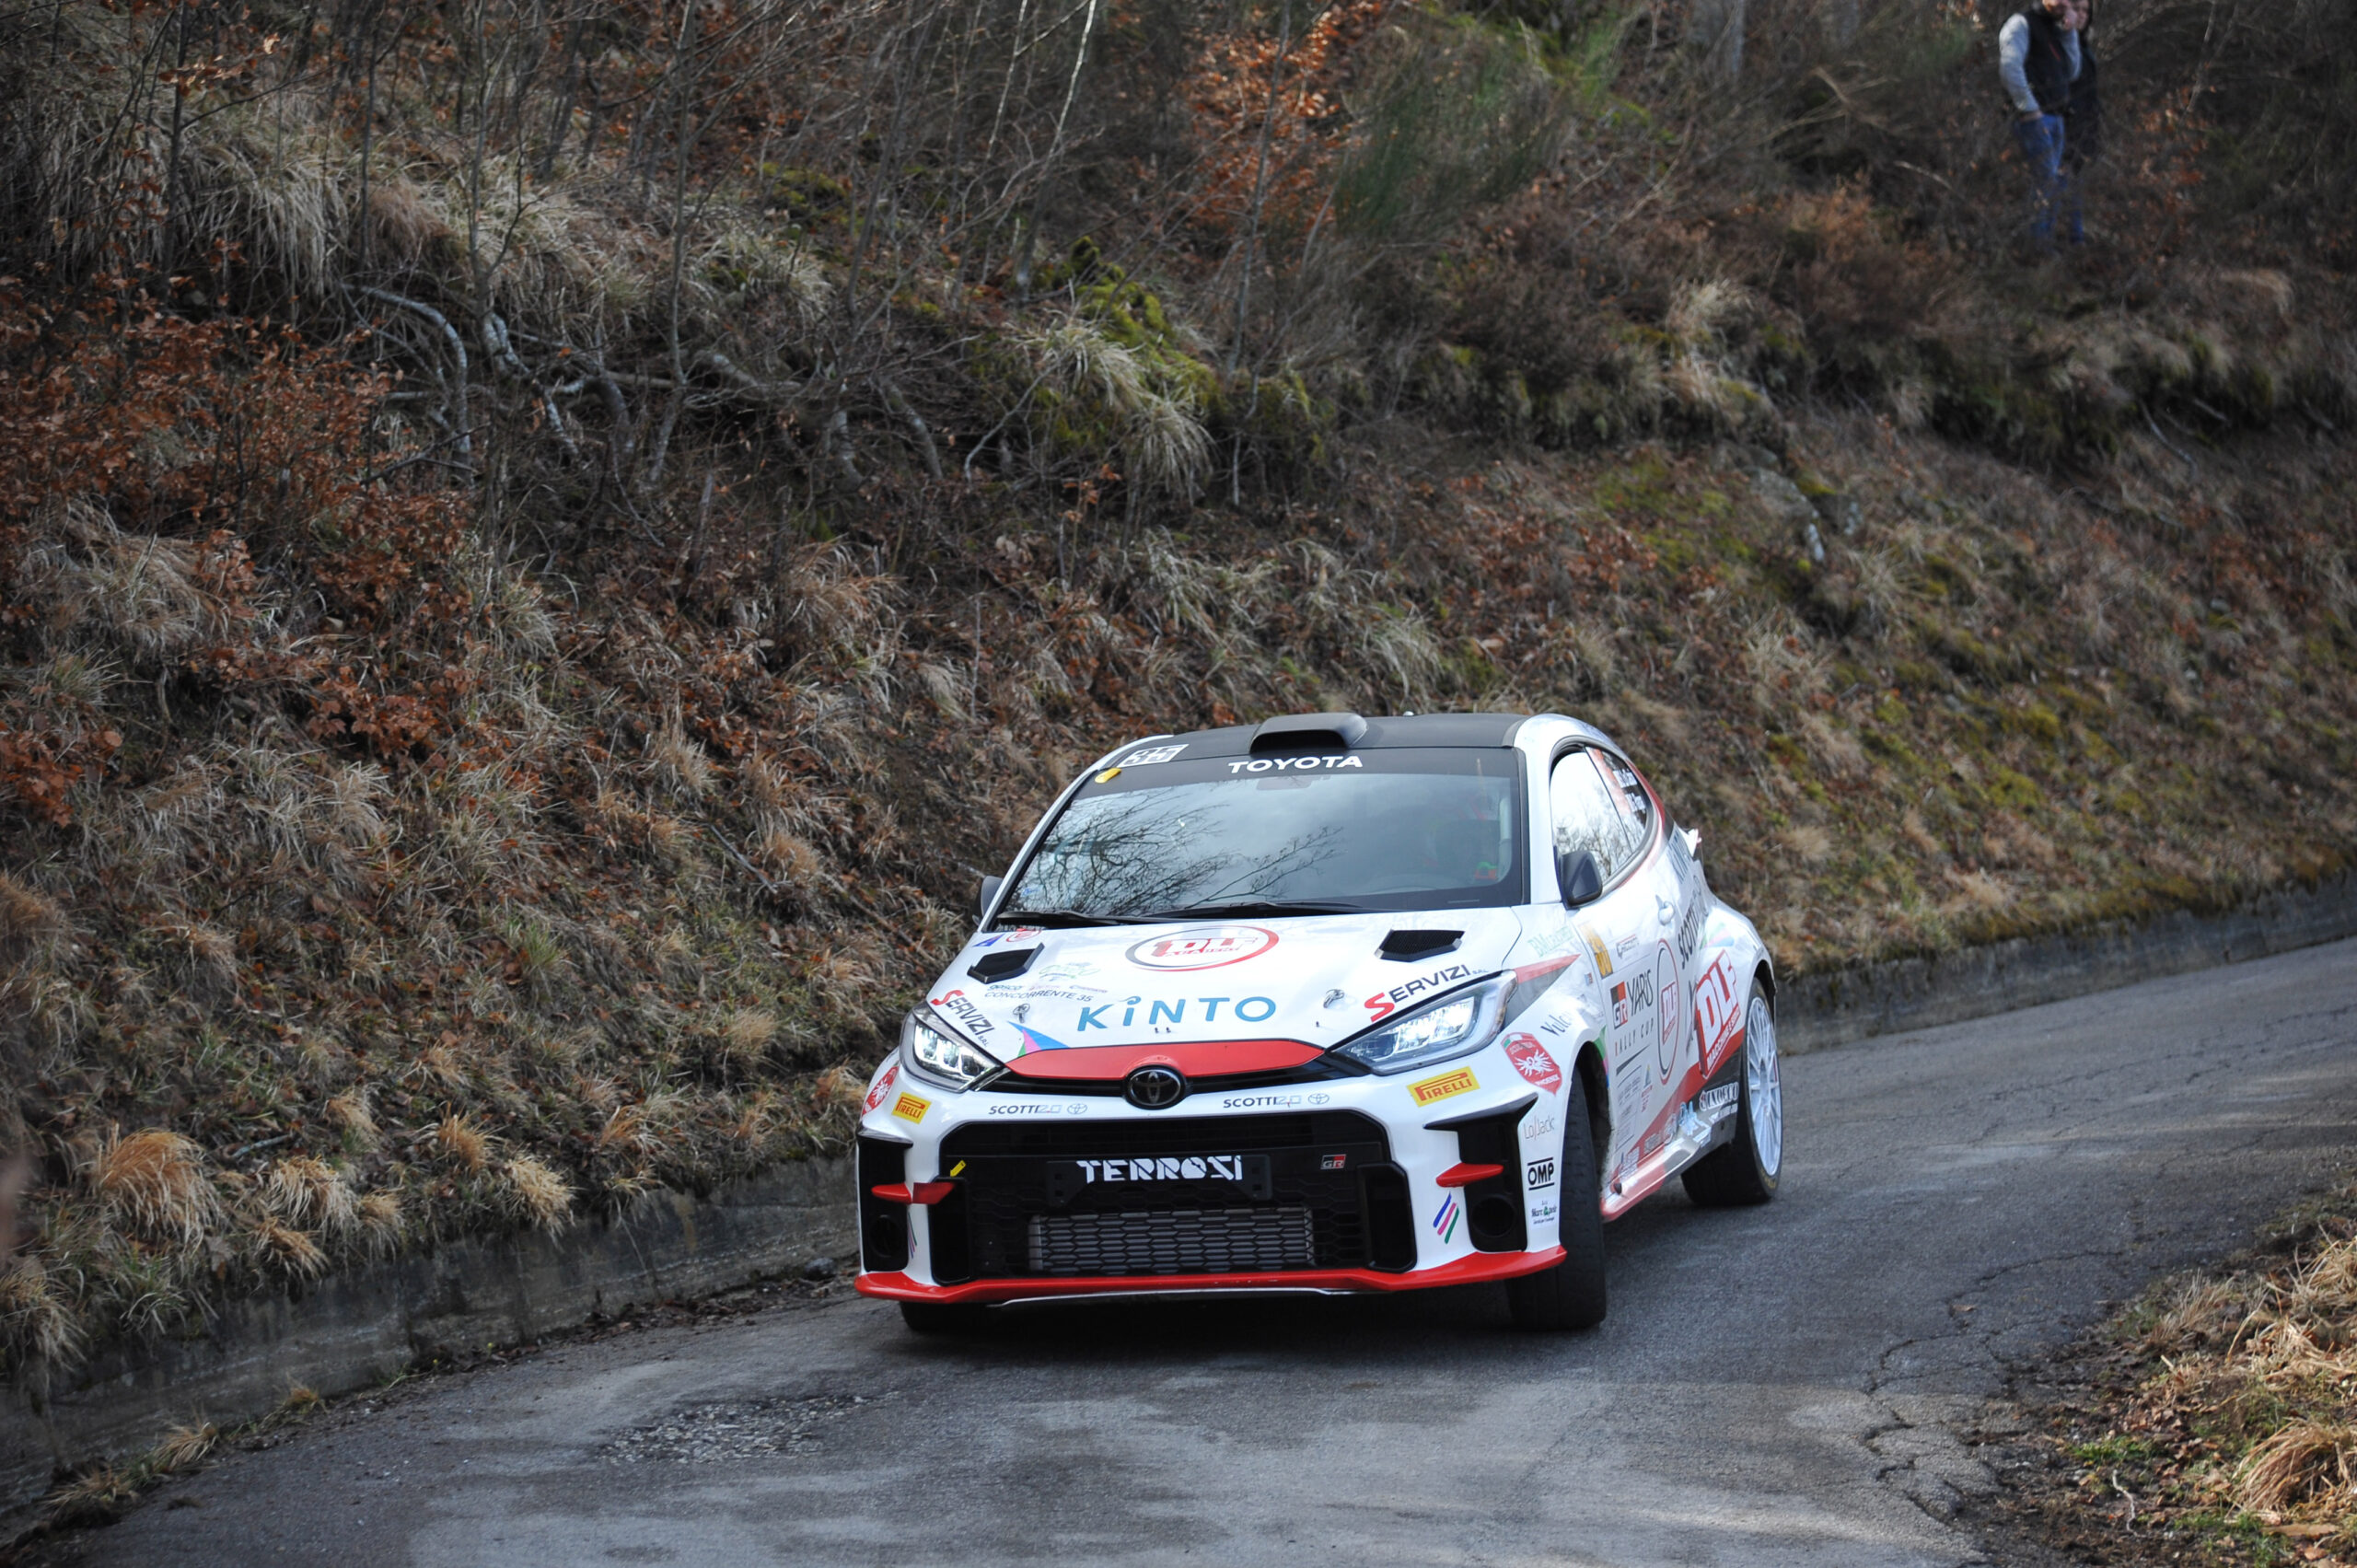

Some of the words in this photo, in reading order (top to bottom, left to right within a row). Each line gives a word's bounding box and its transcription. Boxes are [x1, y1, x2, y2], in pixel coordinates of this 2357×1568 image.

[1228, 755, 1363, 773] TOYOTA
[984, 989, 1076, 999] CONCORRENTE
[1364, 964, 1471, 1023] SERVIZI
[1696, 950, 1737, 1056] DLF
[930, 989, 995, 1036] SERVIZI
[1613, 999, 1628, 1028] GR
[1414, 1072, 1472, 1101] PIRELLI
[895, 1097, 926, 1120] PIRELLI
[1527, 1162, 1554, 1186] OMP
